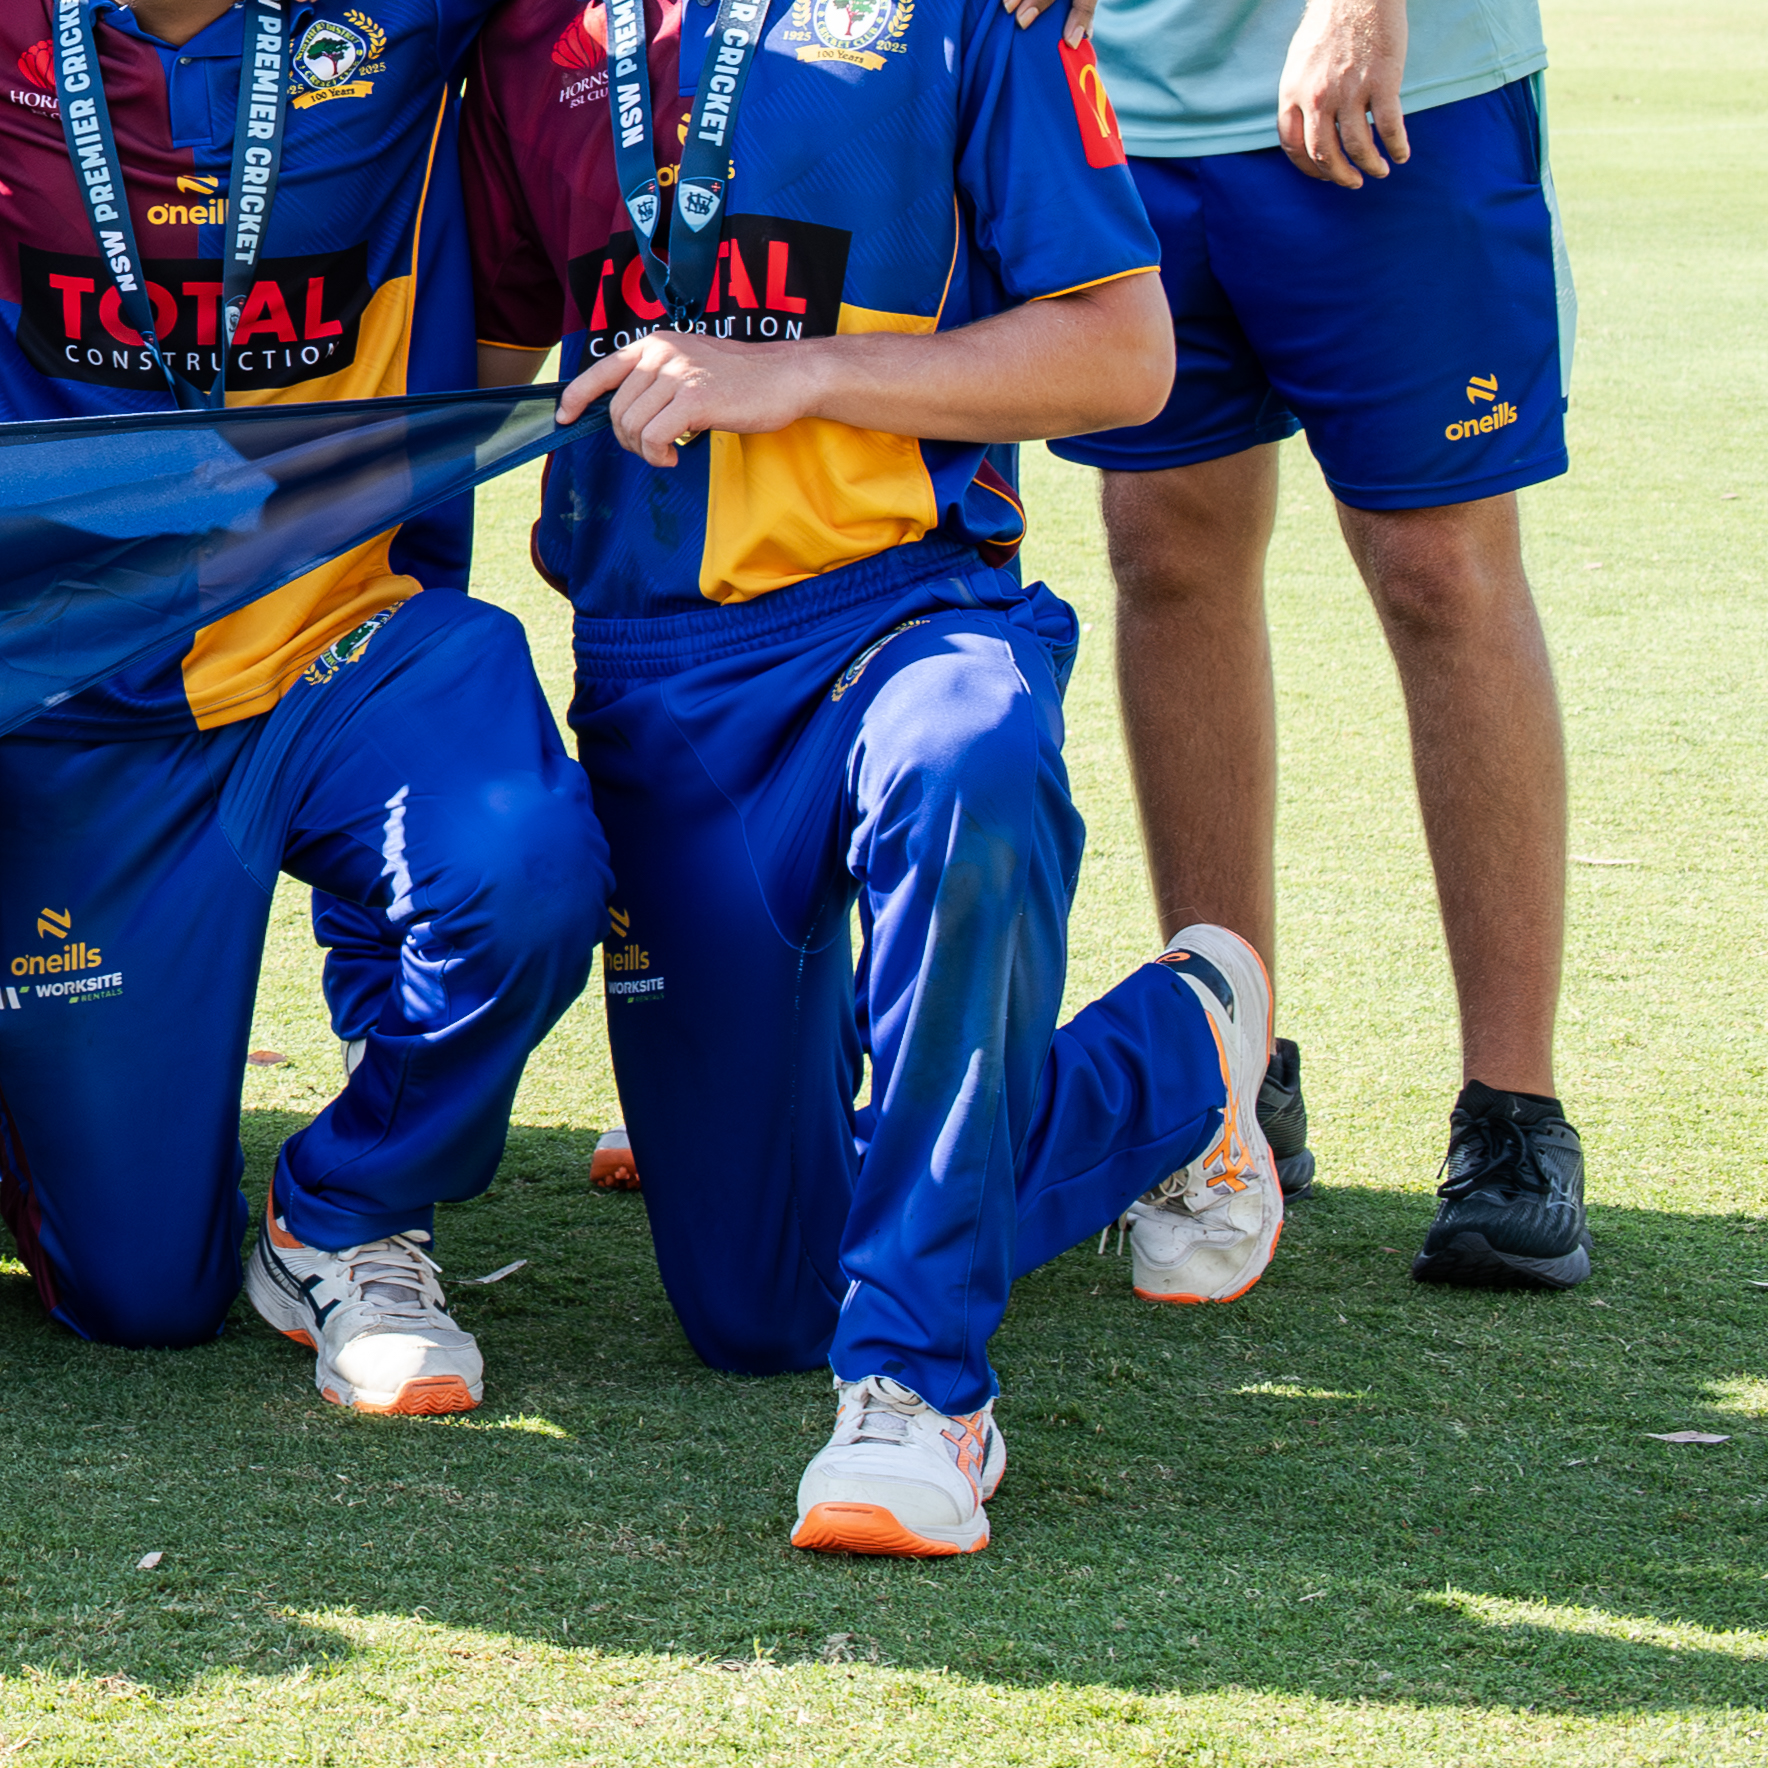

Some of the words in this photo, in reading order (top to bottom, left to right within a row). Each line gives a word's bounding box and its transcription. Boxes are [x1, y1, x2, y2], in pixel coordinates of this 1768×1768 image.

[783, 30, 812, 42] 1925
[875, 40, 907, 54] 2025
[359, 62, 386, 77] 2025
[816, 48, 836, 61] 100
[836, 49, 864, 64] Years
[250, 15, 282, 140] PREMIER
[697, 28, 752, 147] CRICKET
[309, 89, 331, 103] 100
[332, 85, 356, 98] Years
[616, 82, 644, 149] NSW
[71, 99, 119, 222] PREMIER
[147, 199, 229, 226] o'neill
[235, 143, 271, 265] CRICKET
[100, 230, 138, 292] NSW
[49, 273, 344, 347] TOTAL
[35, 972, 122, 998] WORKSITE
[80, 988, 123, 1002] RENTALS
[608, 977, 664, 994] WORKSITE
